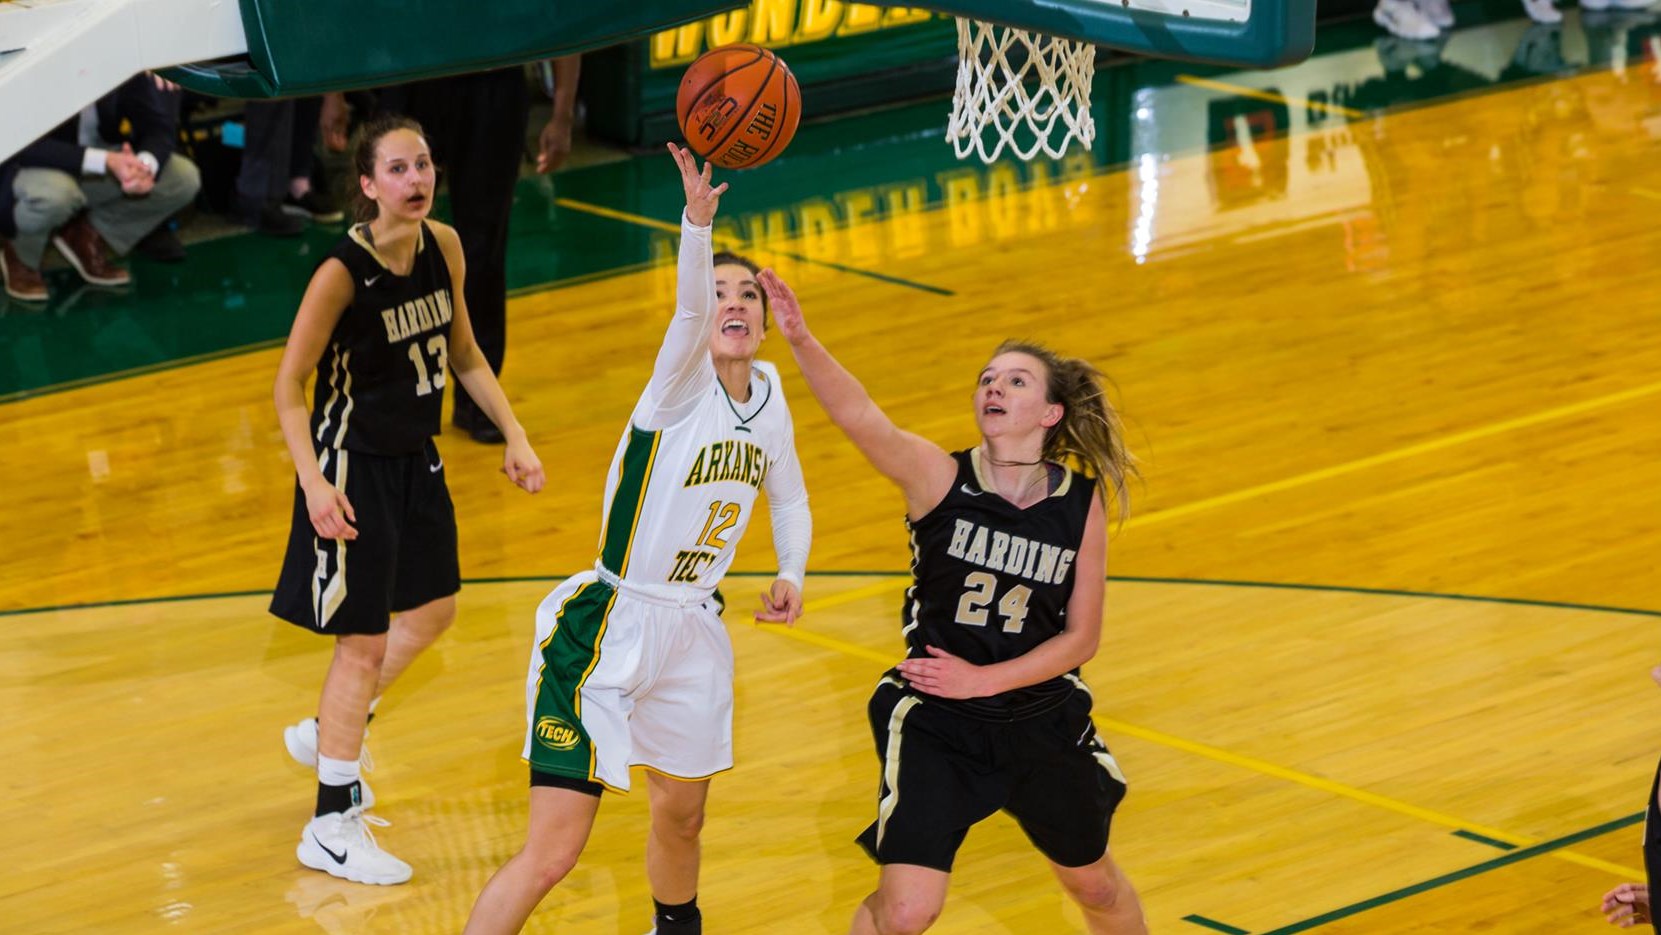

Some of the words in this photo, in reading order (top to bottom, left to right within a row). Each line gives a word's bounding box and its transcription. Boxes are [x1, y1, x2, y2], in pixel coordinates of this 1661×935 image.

[746, 103, 777, 141] THE
[381, 288, 453, 344] HARDIN
[408, 334, 448, 397] 13
[695, 500, 741, 549] 12
[947, 518, 1076, 585] HARDING
[954, 571, 1033, 633] 24
[540, 722, 575, 744] TECH
